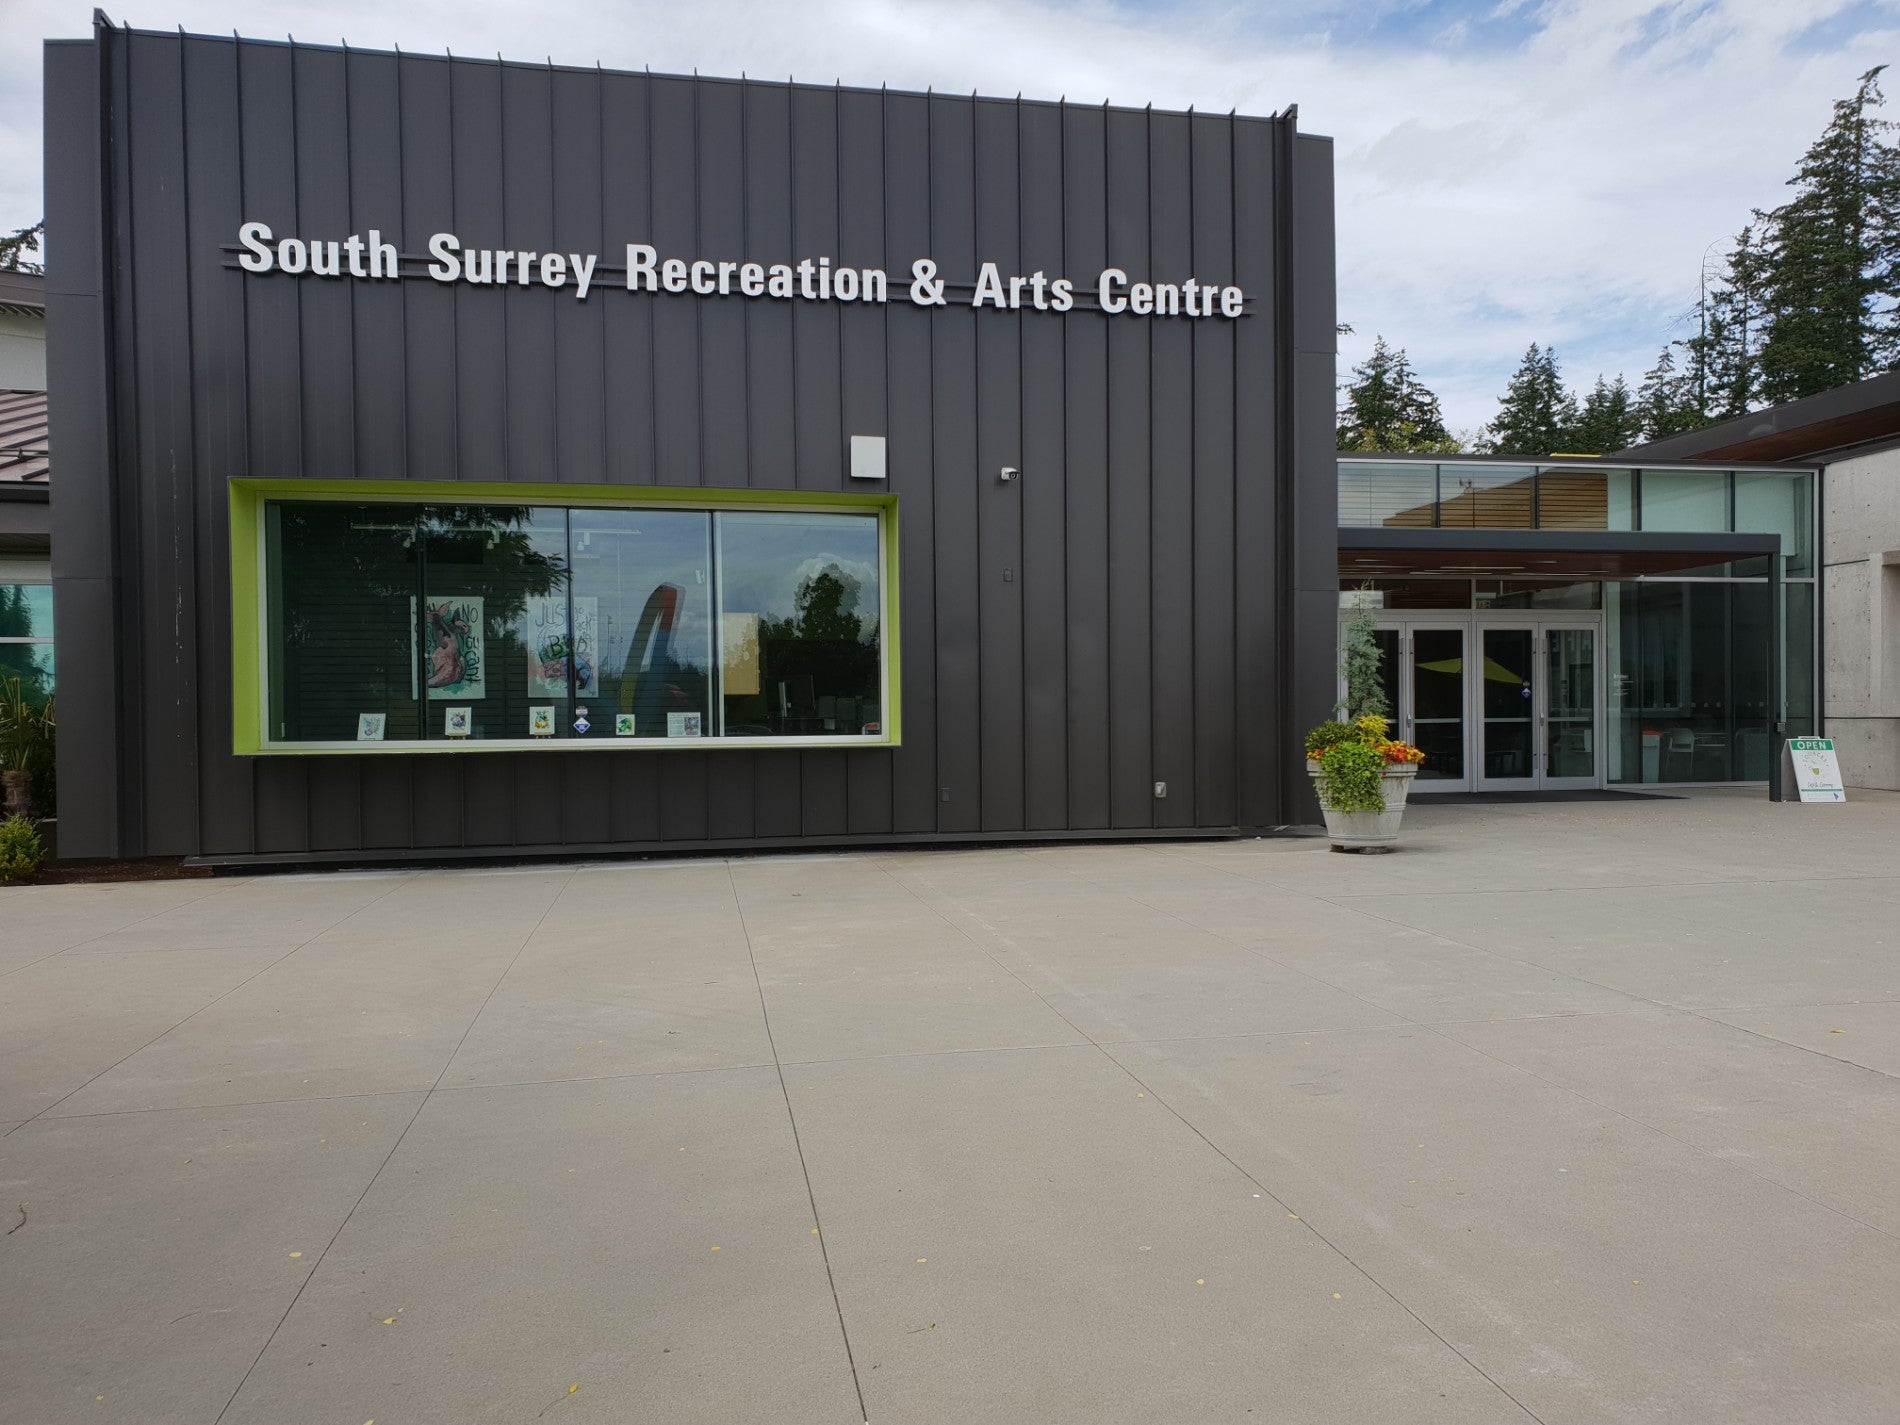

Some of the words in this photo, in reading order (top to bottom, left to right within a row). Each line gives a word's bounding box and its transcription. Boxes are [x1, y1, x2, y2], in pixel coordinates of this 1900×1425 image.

[238, 221, 399, 278] South
[428, 232, 598, 299] Surrey
[626, 243, 888, 302] Recreation
[909, 258, 947, 306] &
[972, 262, 1075, 312] Arts
[1099, 268, 1243, 318] Centre
[534, 602, 567, 627] JUS
[548, 635, 588, 656] BD
[1797, 741, 1827, 750] OPEN
